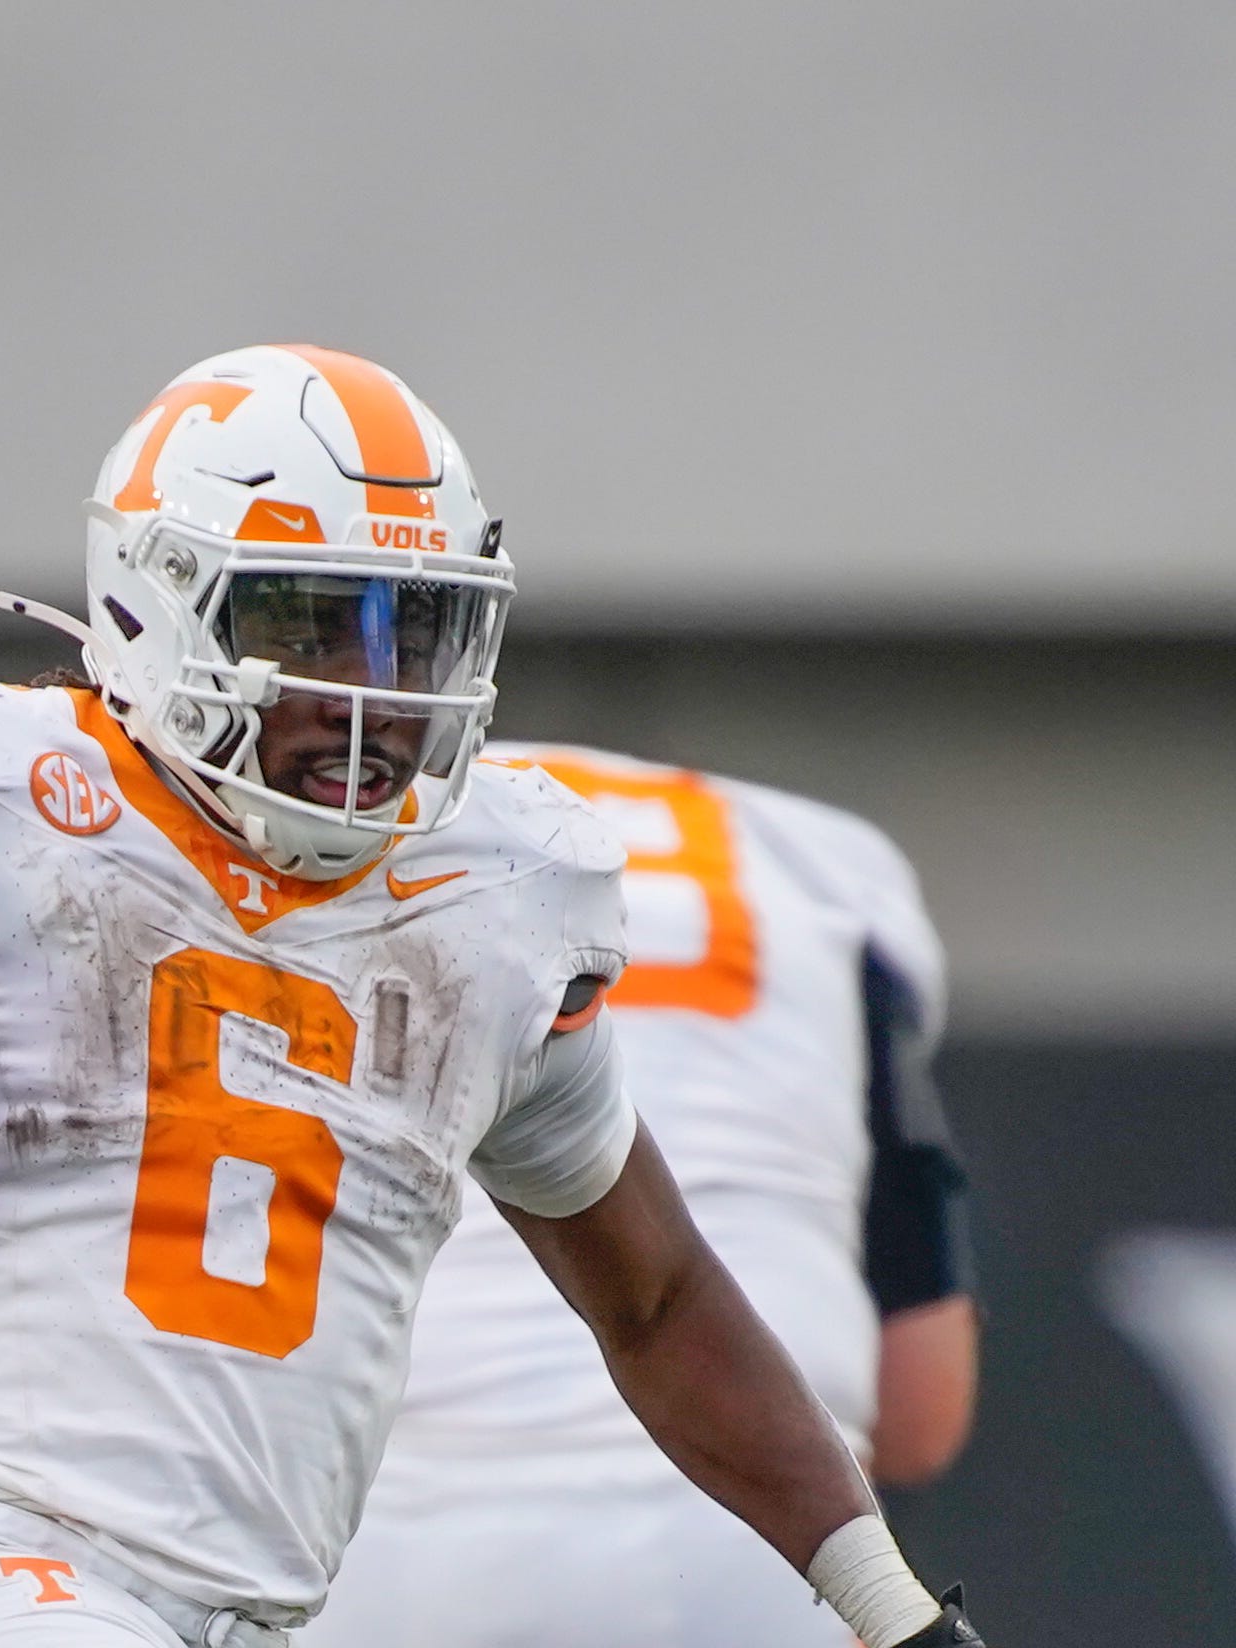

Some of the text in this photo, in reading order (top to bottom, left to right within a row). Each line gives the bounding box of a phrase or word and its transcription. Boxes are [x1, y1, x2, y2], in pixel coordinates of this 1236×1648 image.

[114, 380, 255, 512] T
[371, 521, 446, 552] VOLS
[227, 862, 279, 914] T
[124, 947, 358, 1360] 6
